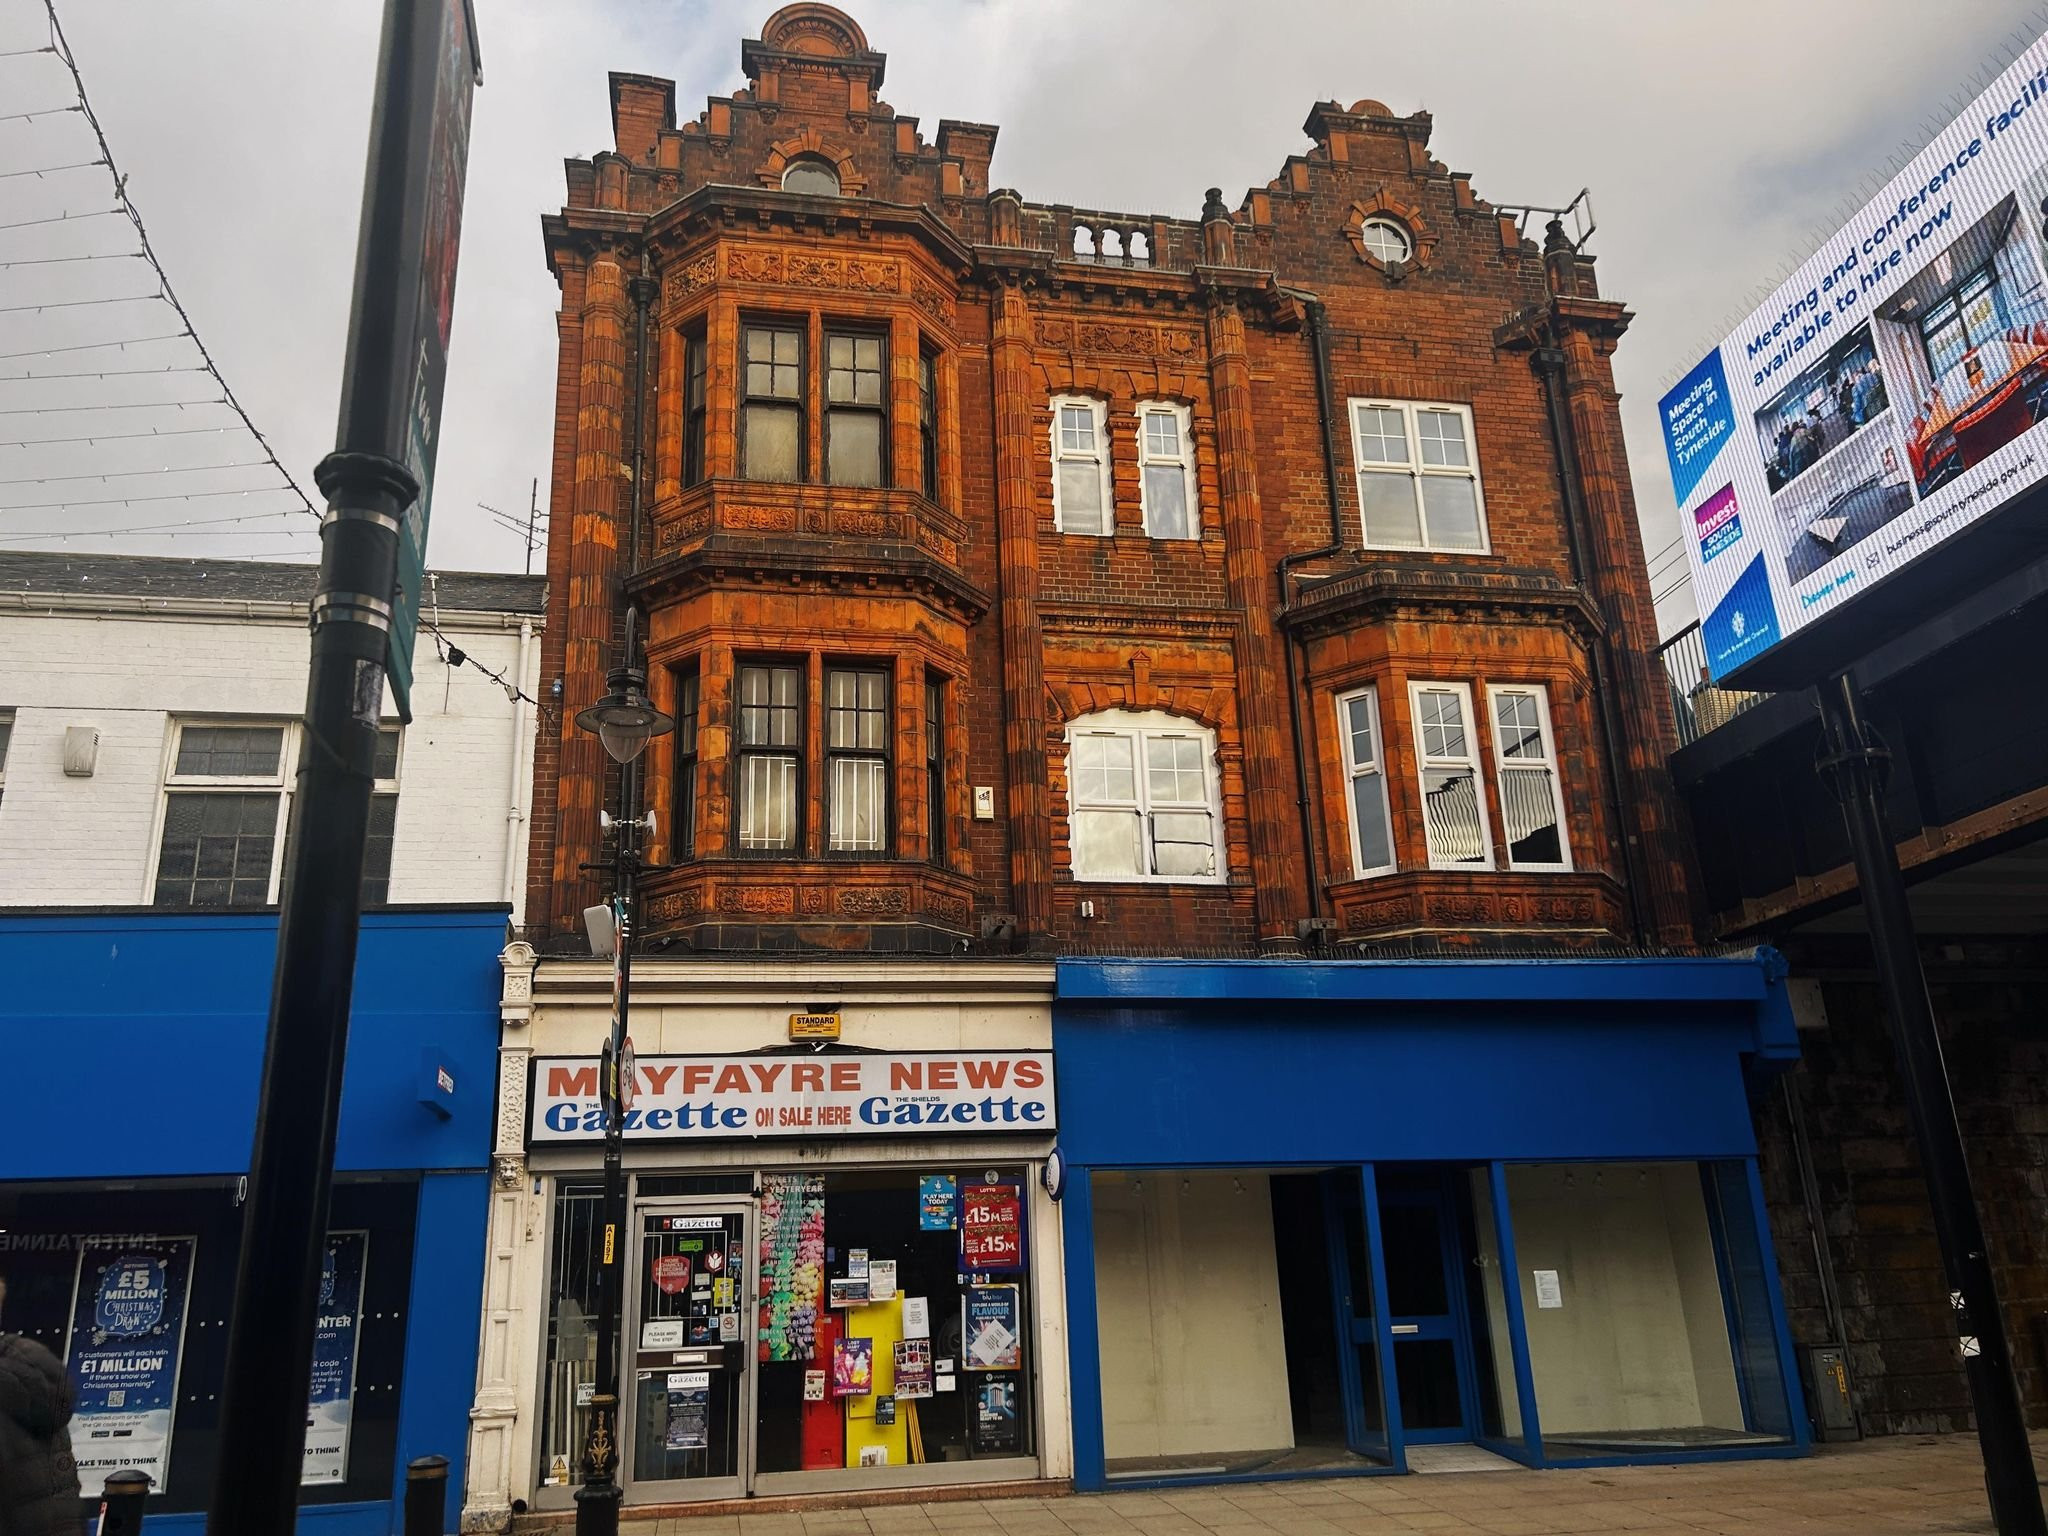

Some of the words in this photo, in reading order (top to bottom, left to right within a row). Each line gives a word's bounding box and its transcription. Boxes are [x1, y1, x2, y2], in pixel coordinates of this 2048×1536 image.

[1746, 287, 1819, 360] Meeting
[1822, 248, 1858, 292] and
[1862, 138, 1981, 255] conference
[1986, 66, 2048, 141] facili
[1754, 310, 1832, 387] available
[1836, 289, 1857, 313] to
[1860, 250, 1900, 294] hire
[1906, 201, 1952, 253] now
[1668, 376, 1713, 422] Meeting
[1672, 402, 1704, 436] Space
[1706, 390, 1718, 407] in
[1674, 417, 1708, 452] South
[1677, 418, 1726, 465] Tyneside
[1698, 499, 1737, 537] Invest
[1704, 527, 1741, 560] TYNESIDE
[1707, 521, 1734, 547] SOUTH
[797, 1017, 835, 1025] STANDARD
[547, 1062, 861, 1097] MYFAYRE
[890, 1060, 1044, 1091] NEWS
[545, 1101, 748, 1132] Gazette
[756, 1107, 774, 1127] ON
[779, 1107, 812, 1127] SALE
[818, 1106, 851, 1126] HERE
[859, 1095, 1046, 1125] Gazette
[770, 1185, 823, 1194] YESTERYEAR
[673, 1219, 722, 1228] Gazette
[966, 1206, 1001, 1224] £15M
[980, 1235, 1016, 1253] £15M
[118, 1270, 149, 1289] £5
[105, 1289, 158, 1300] MILLION
[972, 1307, 1009, 1316] FLAVOUR
[318, 1316, 351, 1328] NTER
[80, 1360, 97, 1373] £1
[100, 1357, 163, 1373] MILLION
[669, 1376, 707, 1384] Gazette
[315, 1446, 340, 1454] THINK
[132, 1457, 157, 1465] THINK
